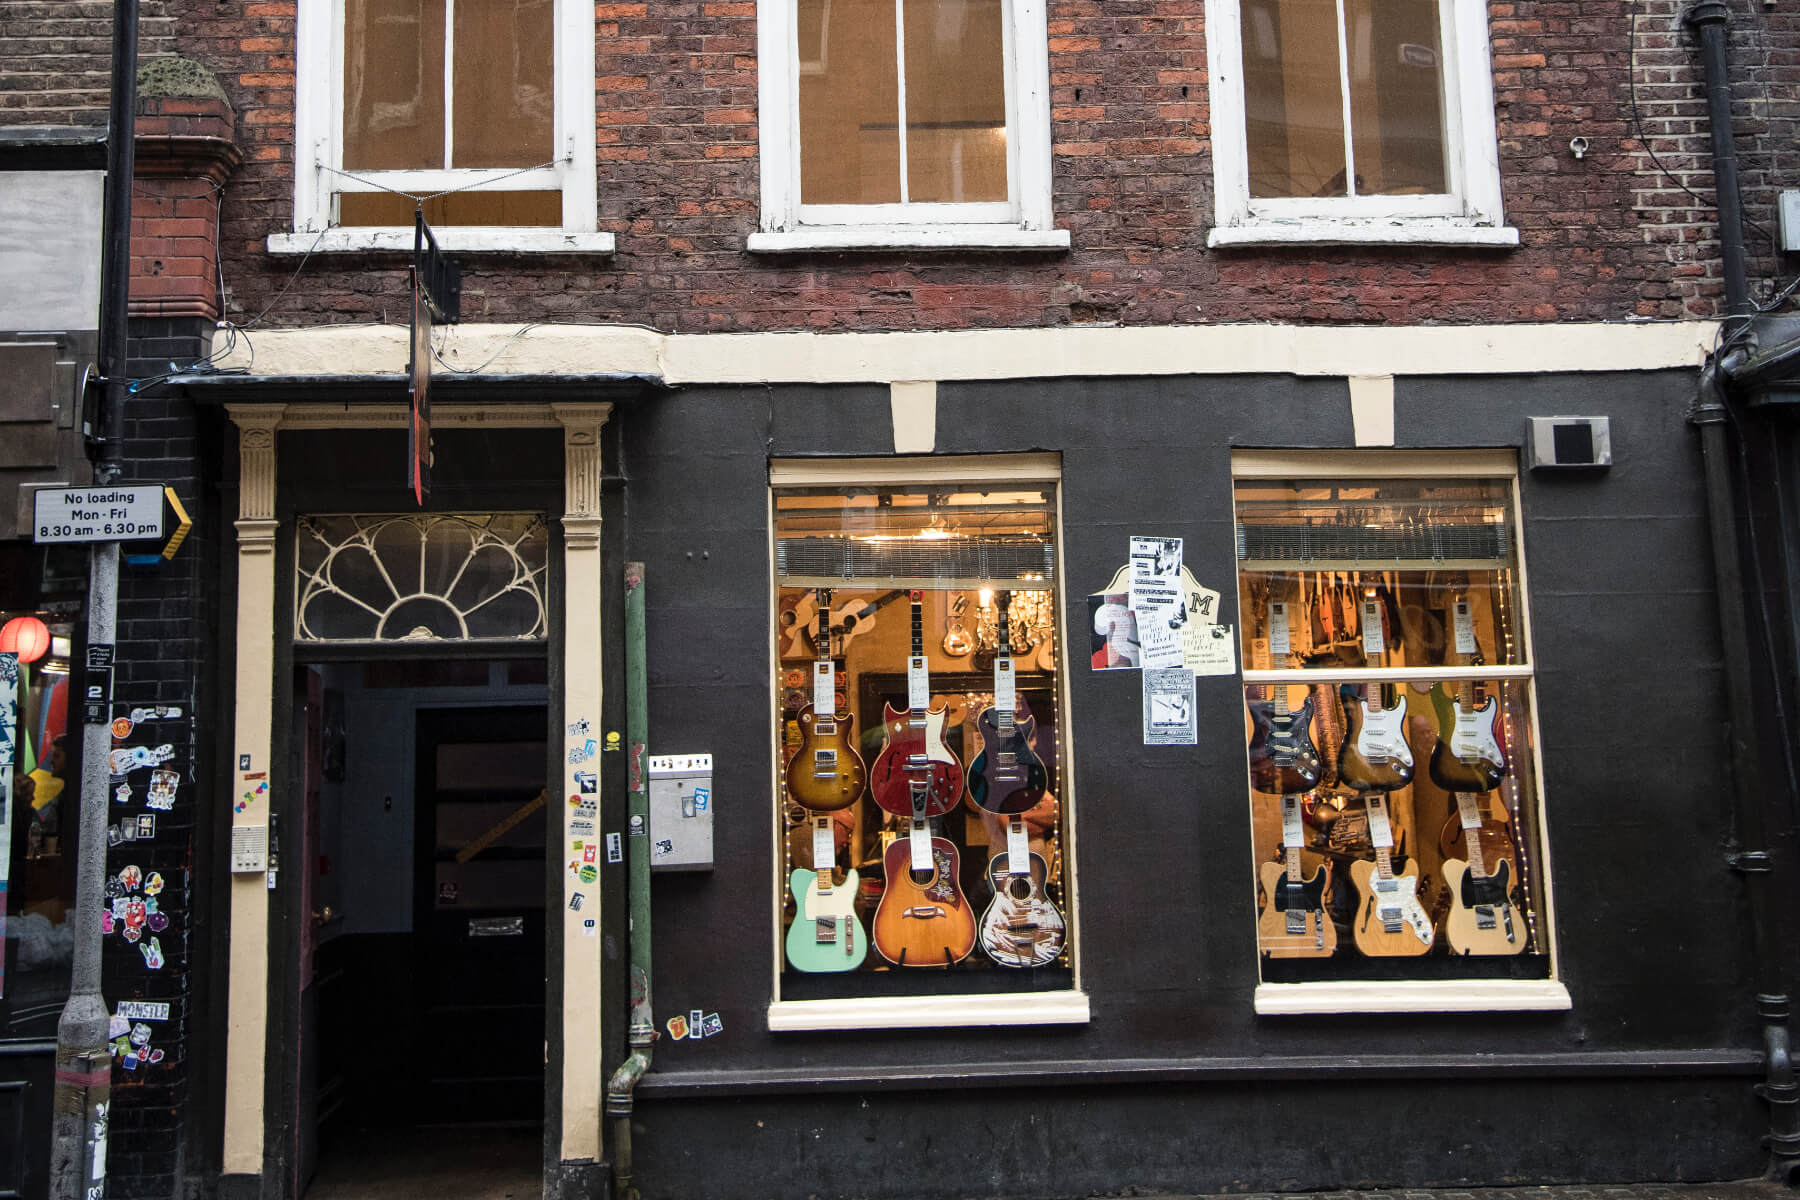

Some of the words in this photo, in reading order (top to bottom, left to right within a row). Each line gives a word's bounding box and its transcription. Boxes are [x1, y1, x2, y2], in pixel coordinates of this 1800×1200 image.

[64, 494, 83, 504] No
[87, 493, 135, 504] loading
[71, 510, 99, 521] Mon
[110, 508, 127, 519] Fri
[40, 525, 72, 537] 8.30
[74, 526, 93, 535] am
[104, 523, 135, 534] 6.30
[137, 524, 157, 535] pm
[88, 686, 103, 698] 2
